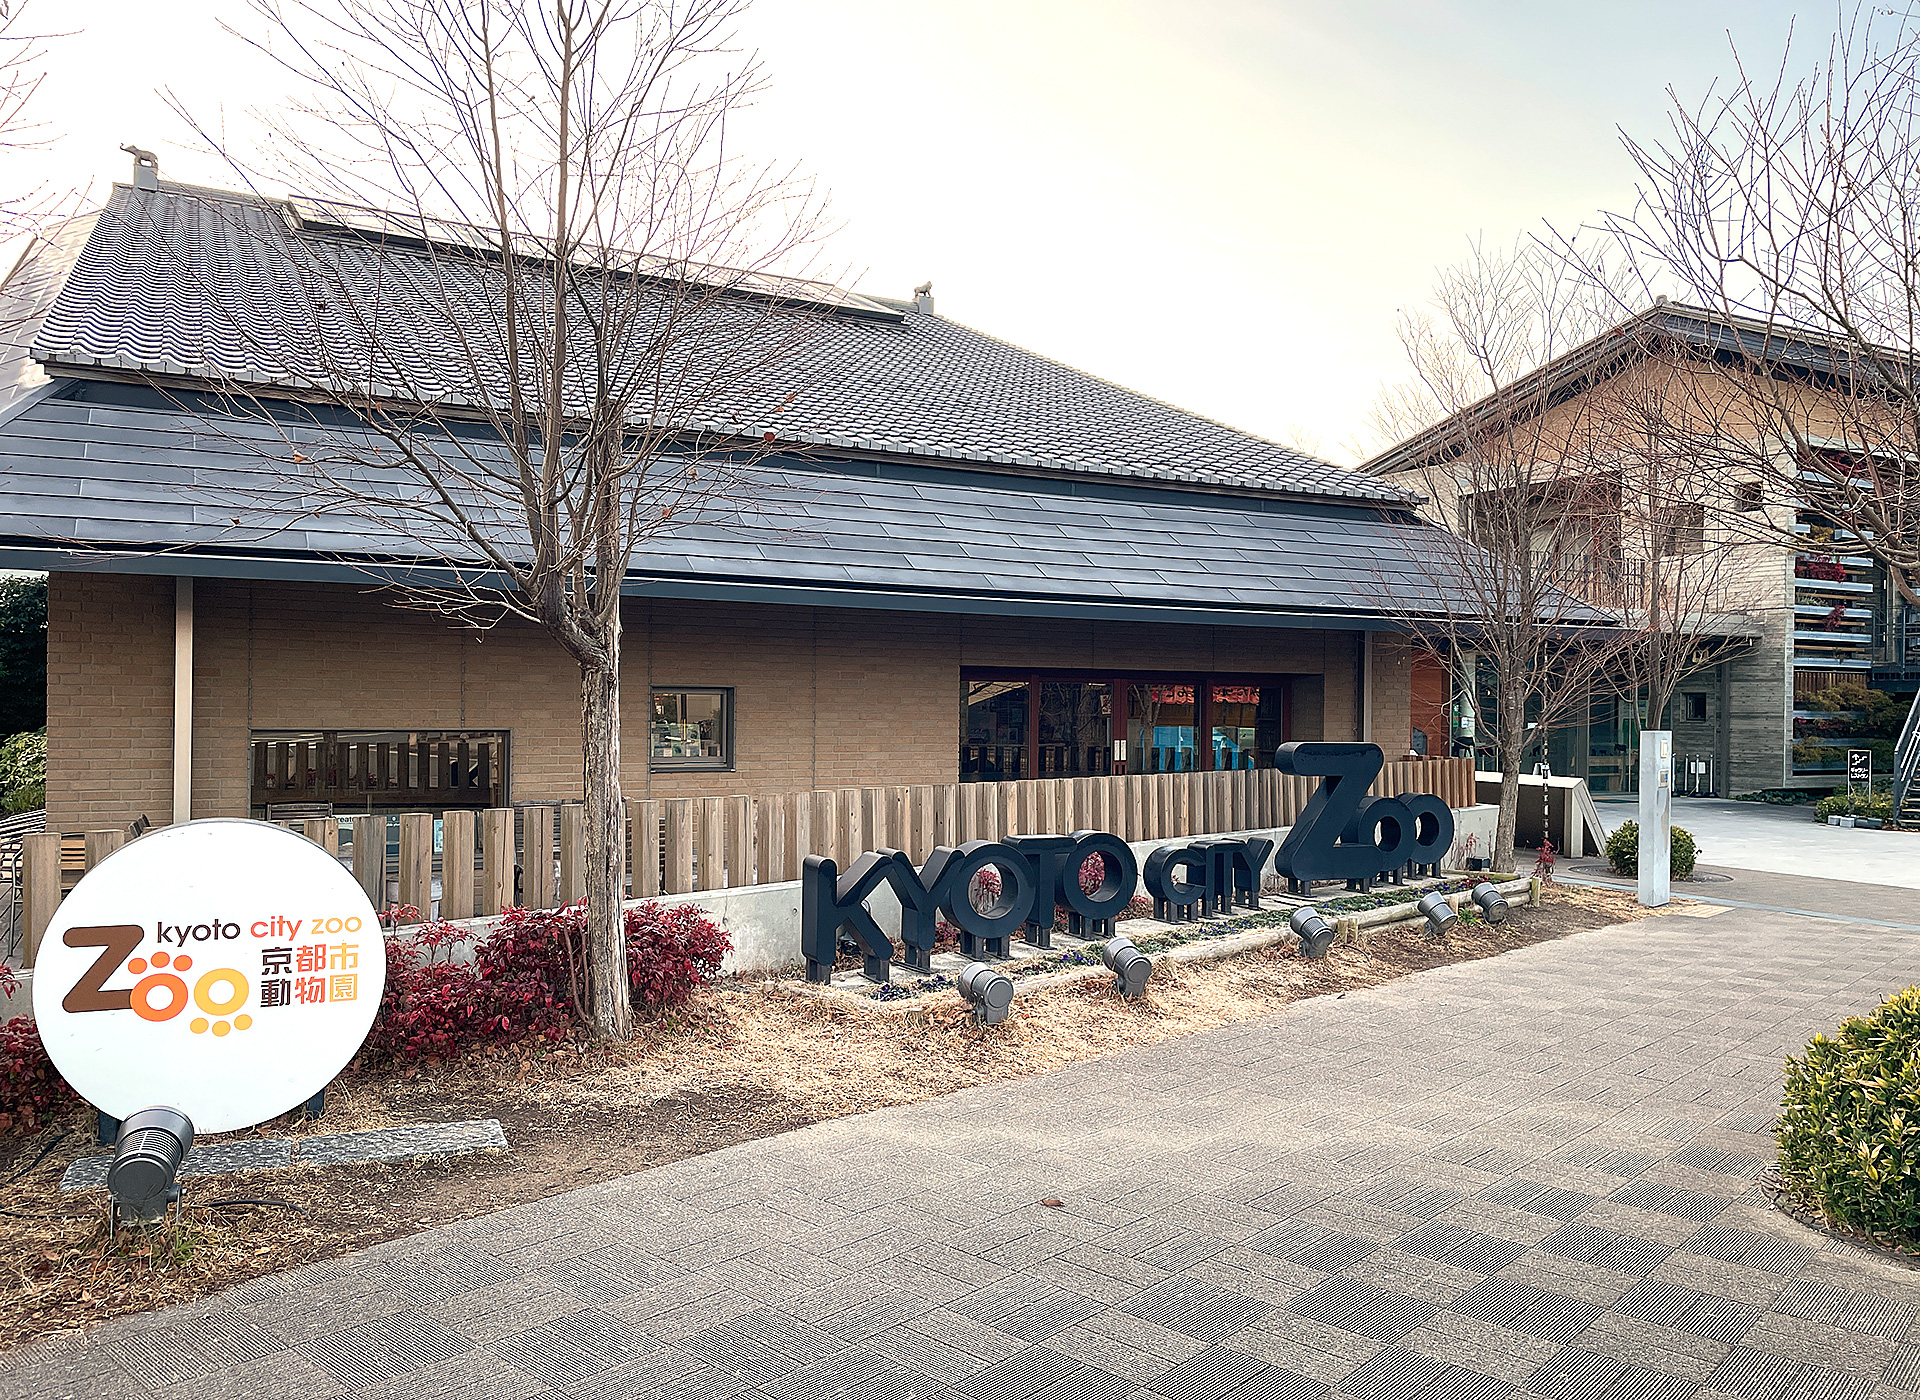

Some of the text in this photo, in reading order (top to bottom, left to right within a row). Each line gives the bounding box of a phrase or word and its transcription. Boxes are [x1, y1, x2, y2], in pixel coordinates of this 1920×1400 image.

[802, 829, 1138, 967] KYOTO
[1143, 836, 1275, 906] CITY
[156, 915, 362, 947] kyoto city zoo
[261, 942, 360, 975] 京都市
[260, 973, 358, 1007] 動物園
